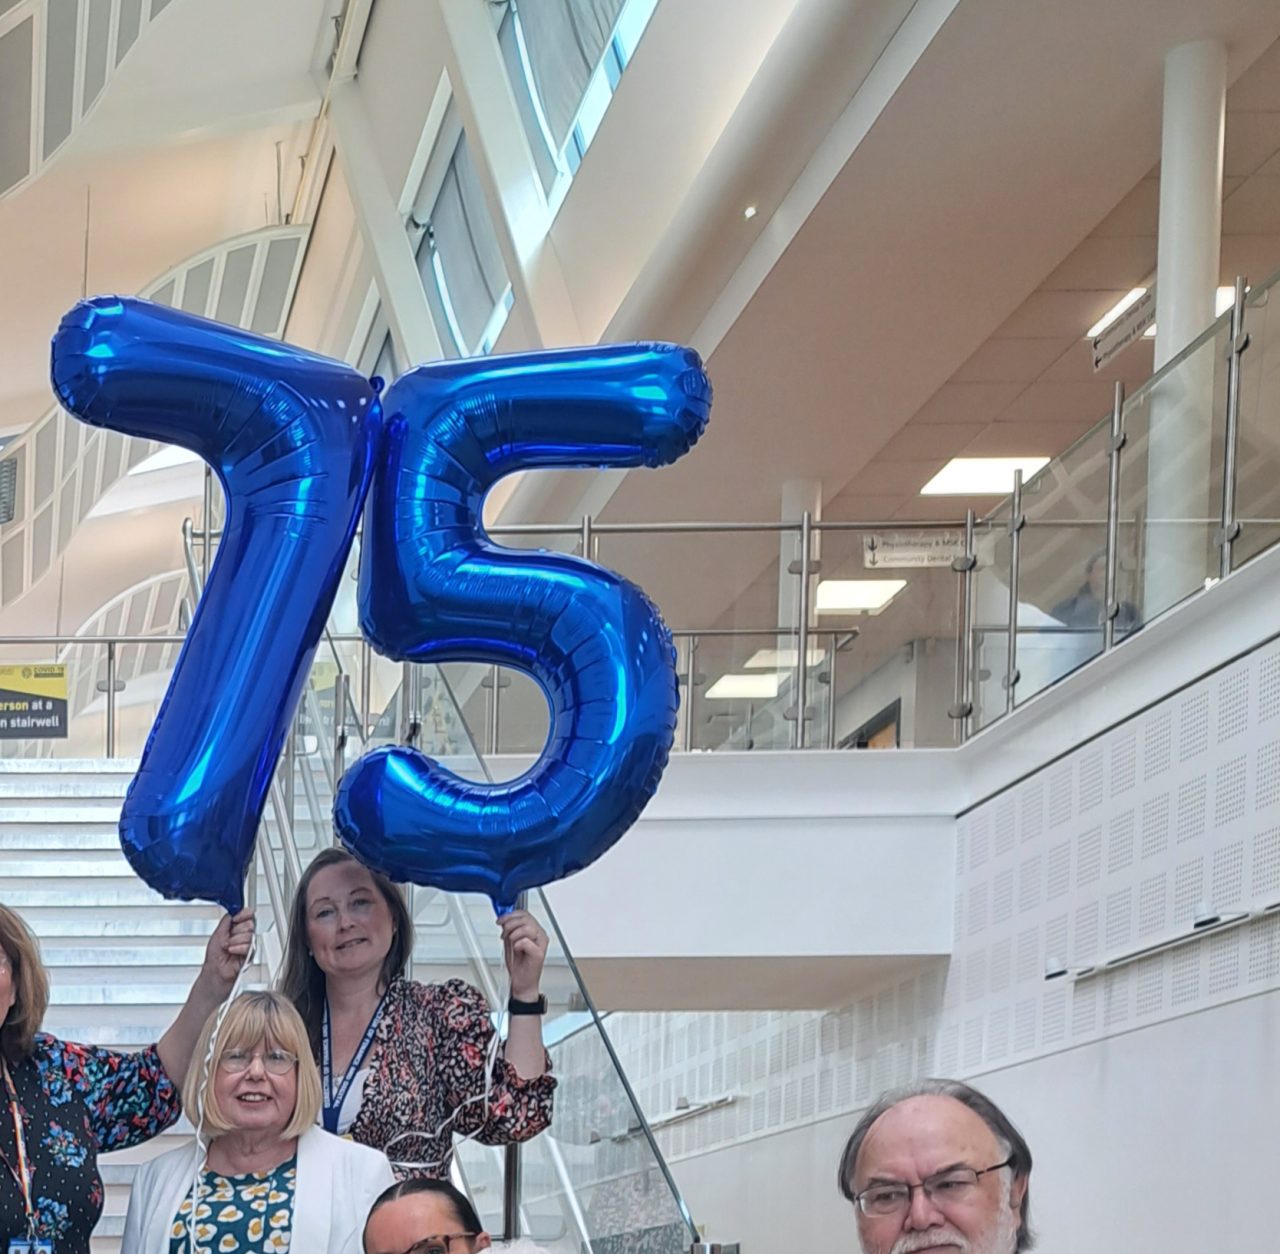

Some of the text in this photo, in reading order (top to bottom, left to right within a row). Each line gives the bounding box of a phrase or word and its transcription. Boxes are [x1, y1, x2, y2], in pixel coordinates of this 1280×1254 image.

[51, 295, 712, 912] 75
[32, 699, 43, 711] at
[46, 701, 53, 711] a
[10, 716, 60, 728] stairwell
[353, 1038, 370, 1067] FINANCE
